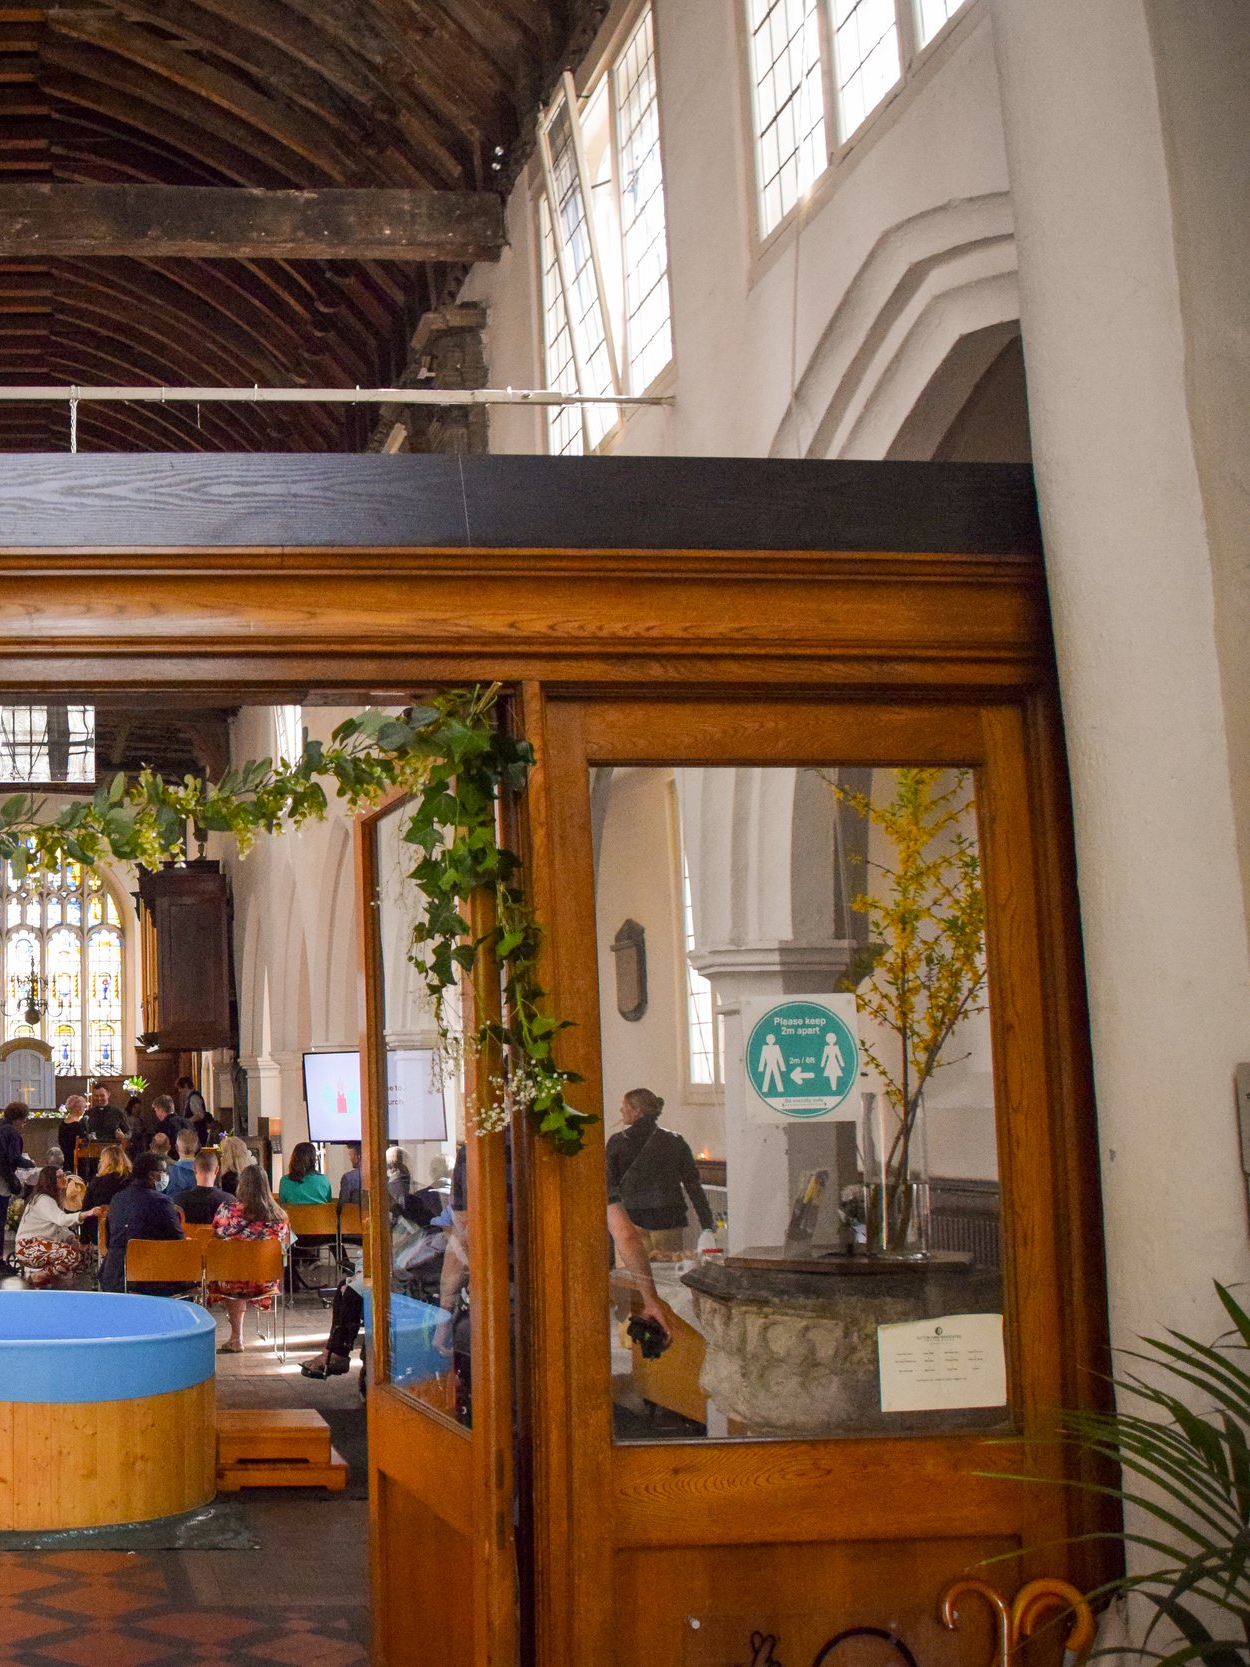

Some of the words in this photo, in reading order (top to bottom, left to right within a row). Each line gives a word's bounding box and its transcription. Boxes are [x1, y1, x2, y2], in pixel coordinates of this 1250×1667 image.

[774, 1017, 804, 1026] Please
[805, 1016, 827, 1027] keep
[781, 1027, 795, 1035] 2m
[797, 1026, 820, 1036] apart
[789, 1057, 801, 1065] 2m
